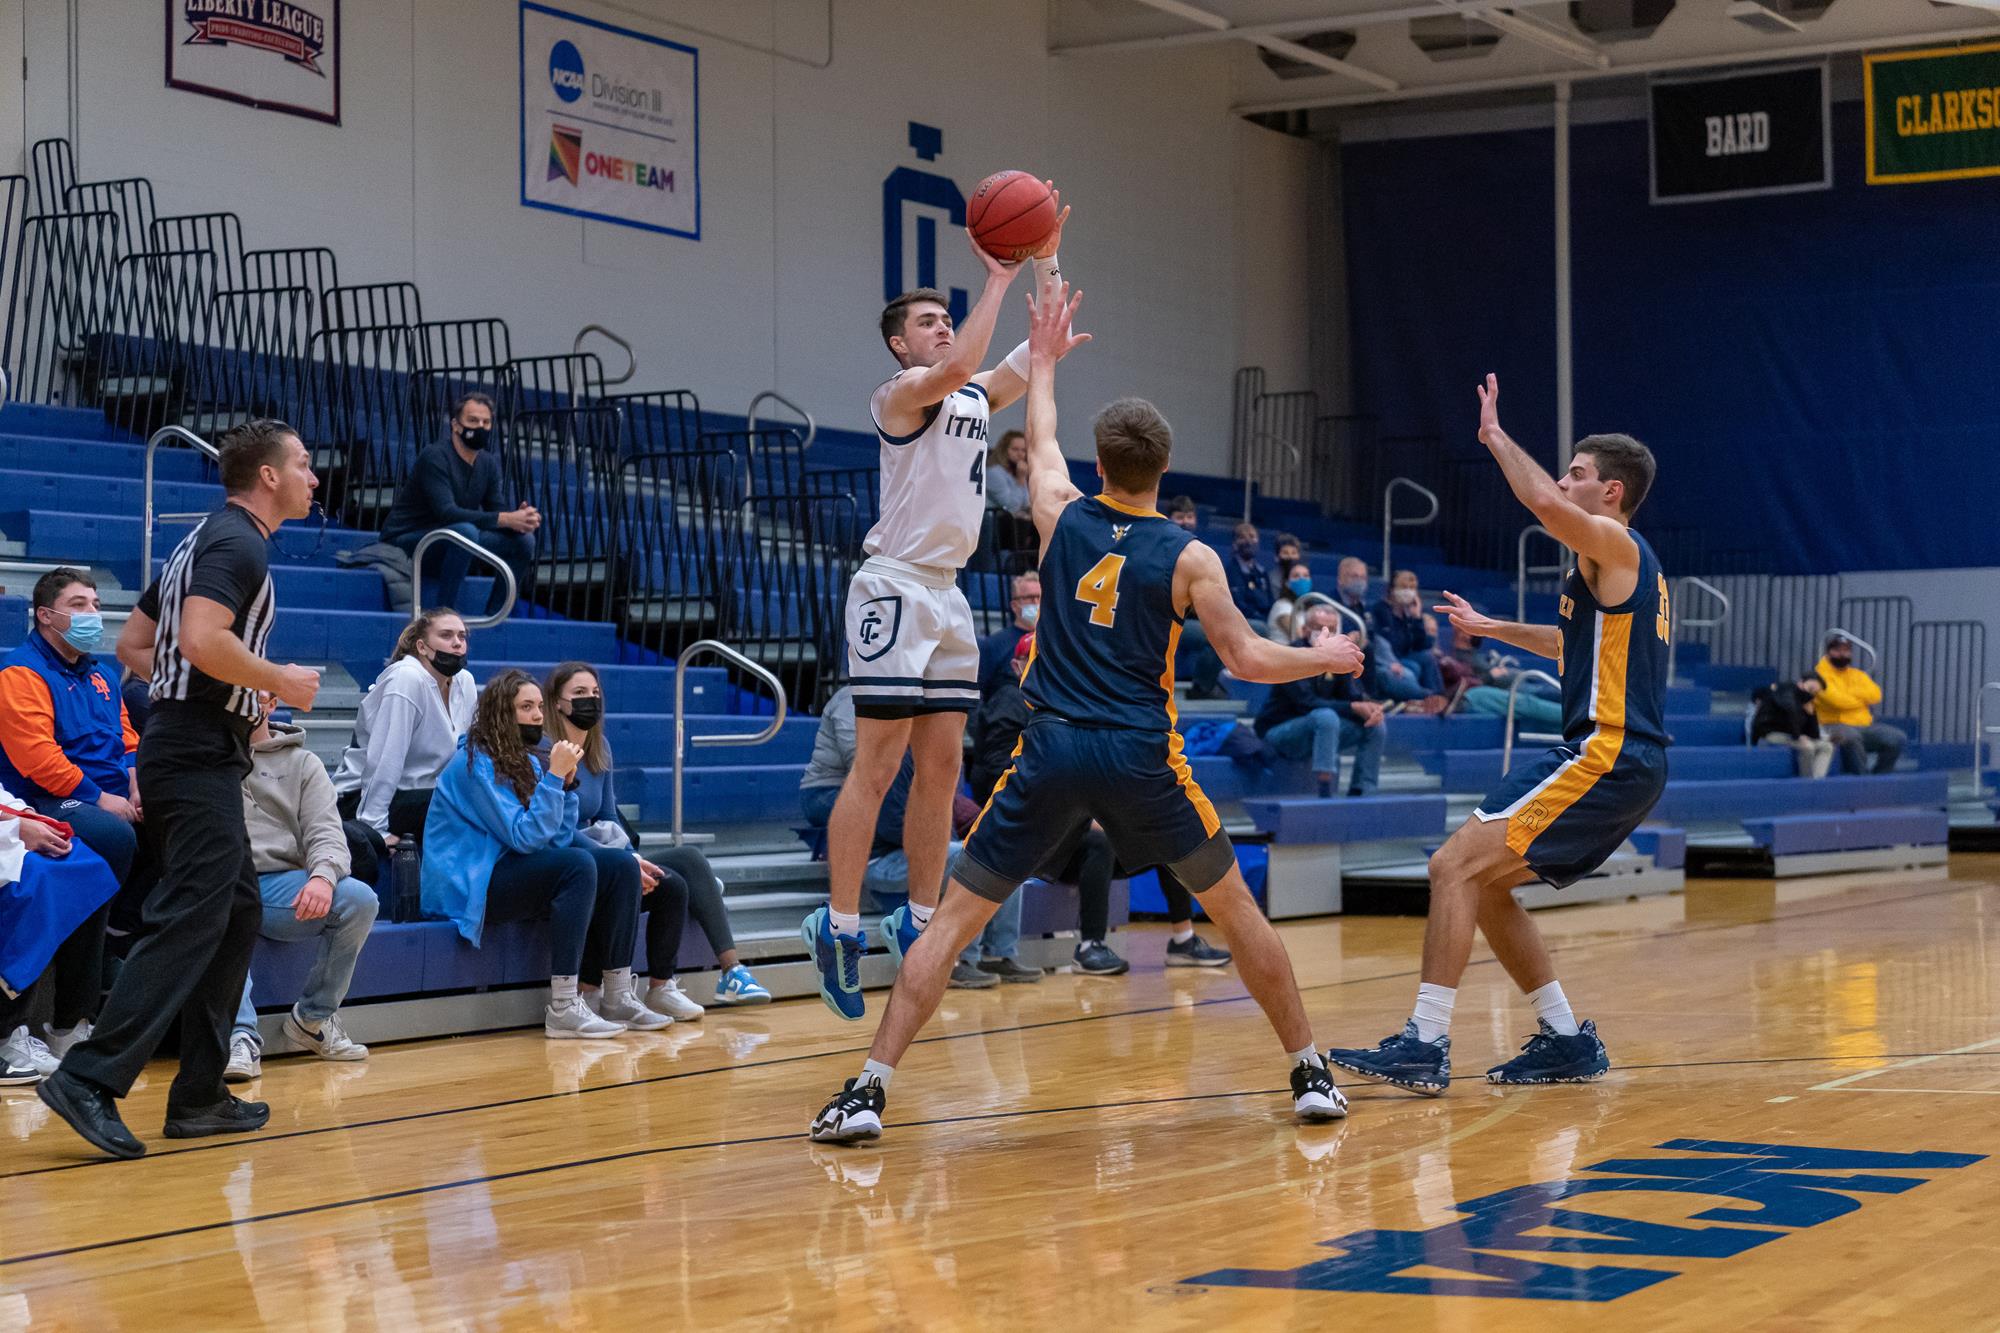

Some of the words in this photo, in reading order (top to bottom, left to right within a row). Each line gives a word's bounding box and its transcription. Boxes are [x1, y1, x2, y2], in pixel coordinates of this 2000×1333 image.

[262, 0, 323, 43] LEAGUE
[552, 68, 584, 89] NCAA
[592, 73, 648, 109] Division
[1705, 112, 1769, 156] BARD
[969, 450, 985, 494] 4
[1075, 552, 1126, 628] 4
[1517, 799, 1549, 832] R
